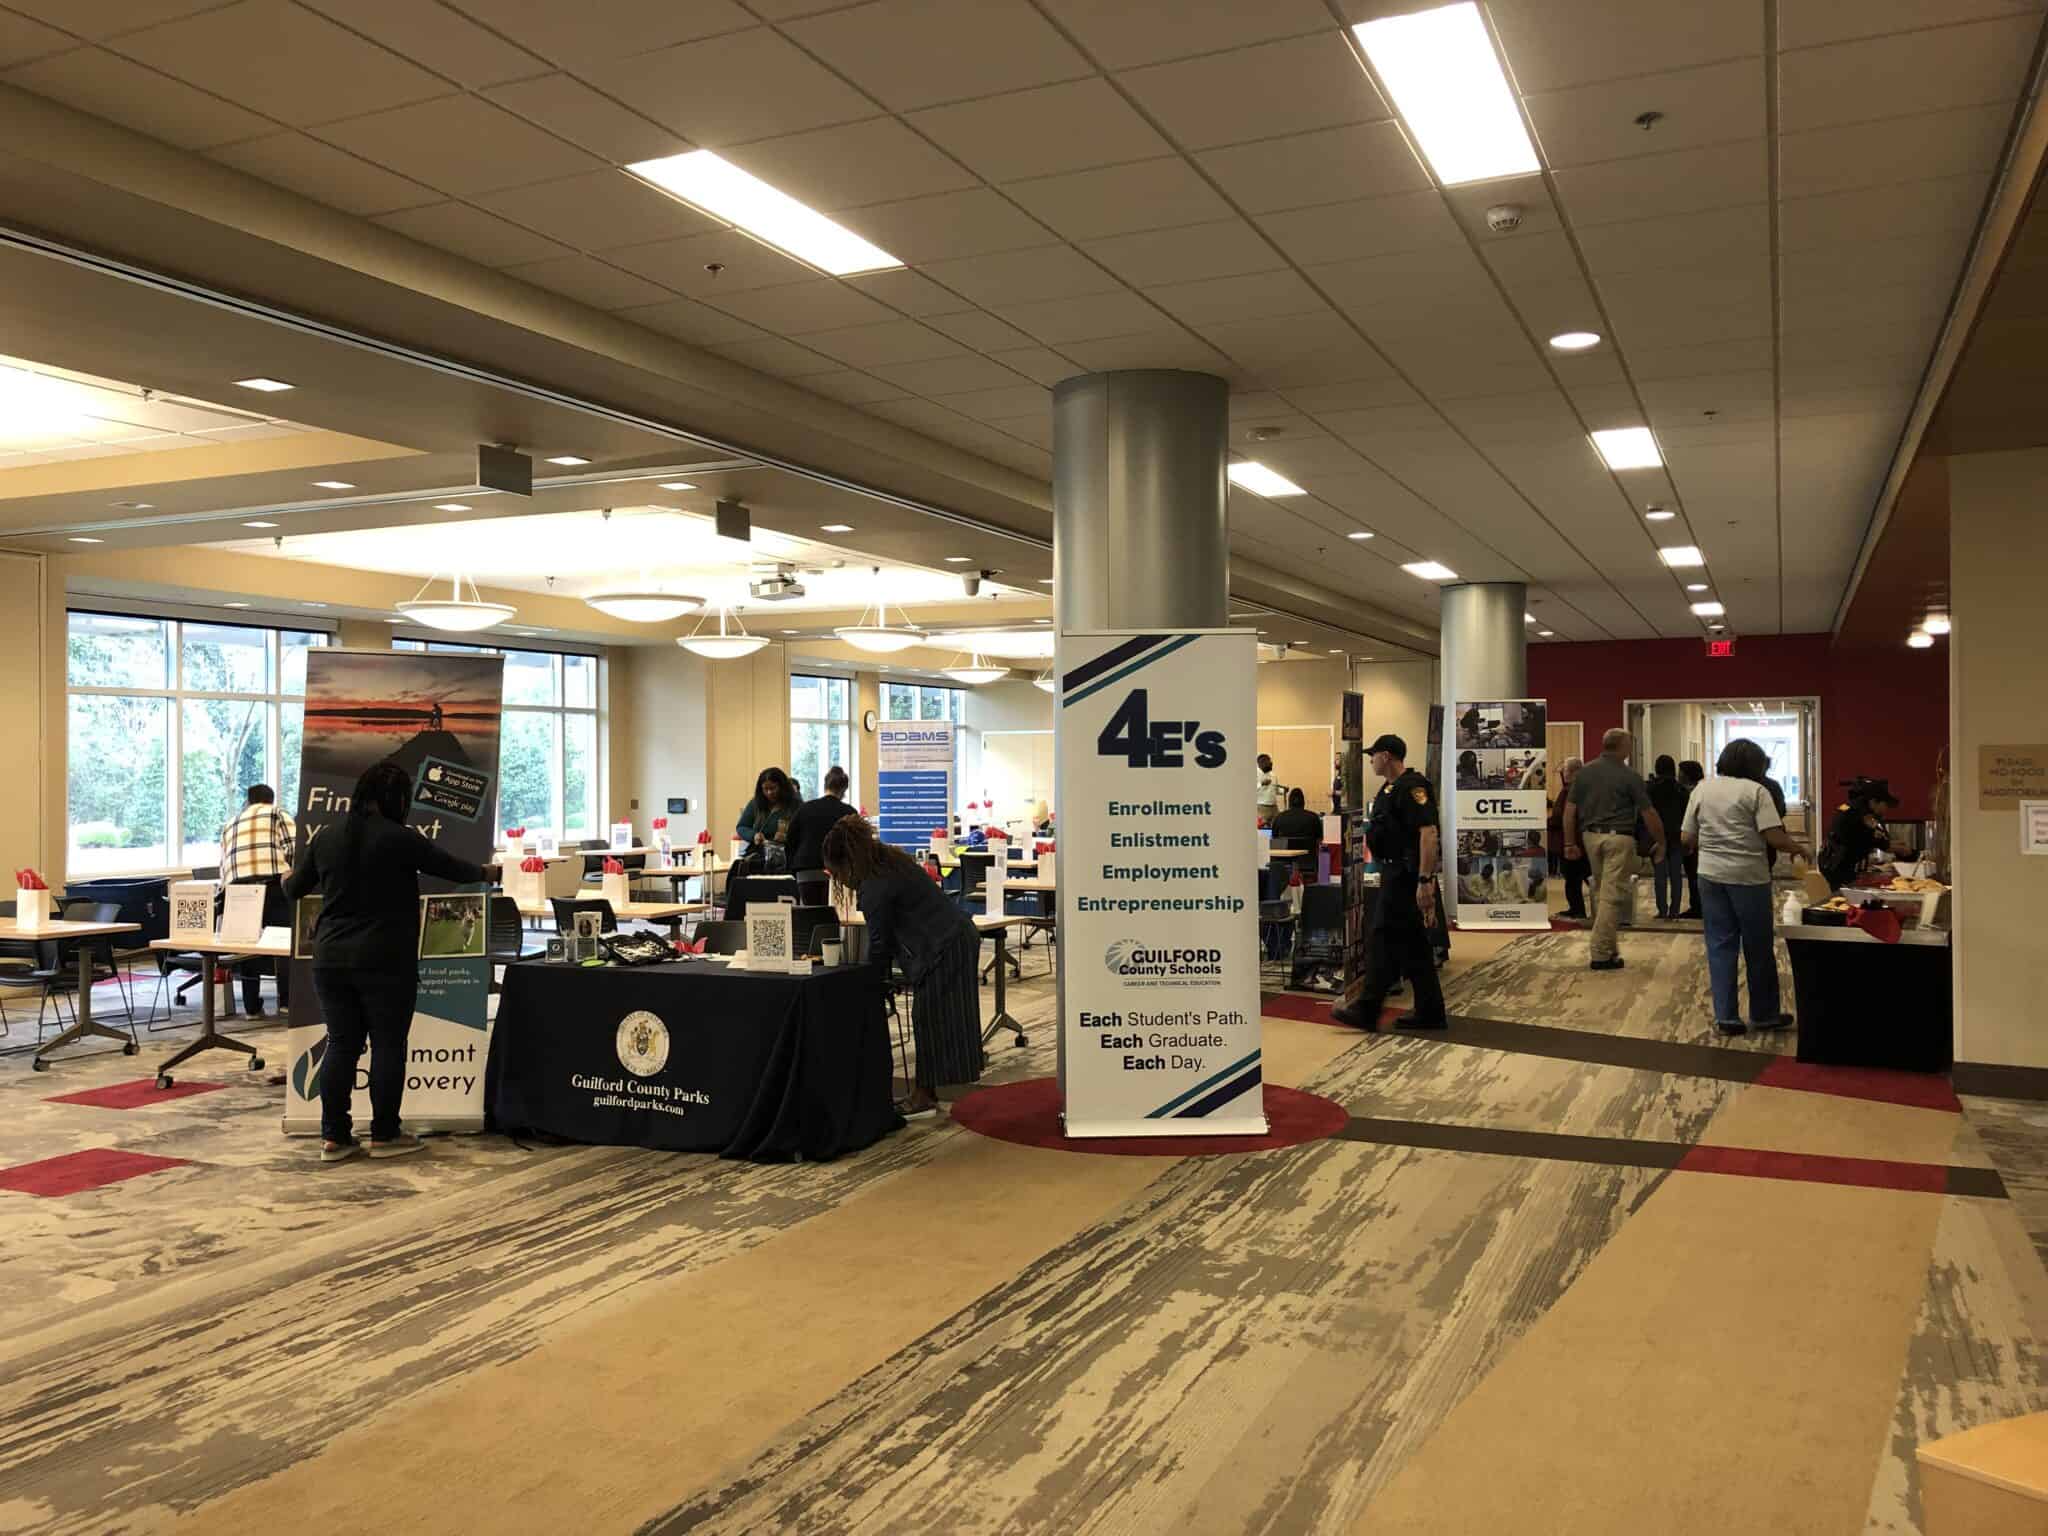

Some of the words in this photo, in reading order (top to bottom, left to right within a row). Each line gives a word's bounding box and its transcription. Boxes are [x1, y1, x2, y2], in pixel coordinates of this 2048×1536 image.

[1711, 641, 1731, 655] EXIT
[1097, 688, 1228, 769] 4E's
[462, 780, 480, 792] Store
[307, 786, 351, 812] Fin
[1476, 799, 1528, 814] CTE...
[1108, 801, 1212, 817] Enrollment
[1110, 832, 1210, 848] Enlistment
[1102, 864, 1219, 882] Employment
[1078, 895, 1245, 914] Entrepreneurship
[1131, 949, 1221, 963] GUILFORD
[1119, 964, 1167, 976] County
[1169, 963, 1222, 975] Schools
[1079, 1012, 1122, 1027] Each
[1127, 1011, 1201, 1026] Student's
[1207, 1010, 1248, 1025] Path.
[1100, 1034, 1143, 1049] Each
[1148, 1033, 1228, 1048] Graduate.
[1123, 1055, 1166, 1070] Each
[1171, 1055, 1206, 1072] Day.
[571, 1073, 624, 1092] Guilford
[627, 1079, 671, 1100] County
[673, 1087, 710, 1105] Parks
[593, 1094, 685, 1116] guilfordparks.com
